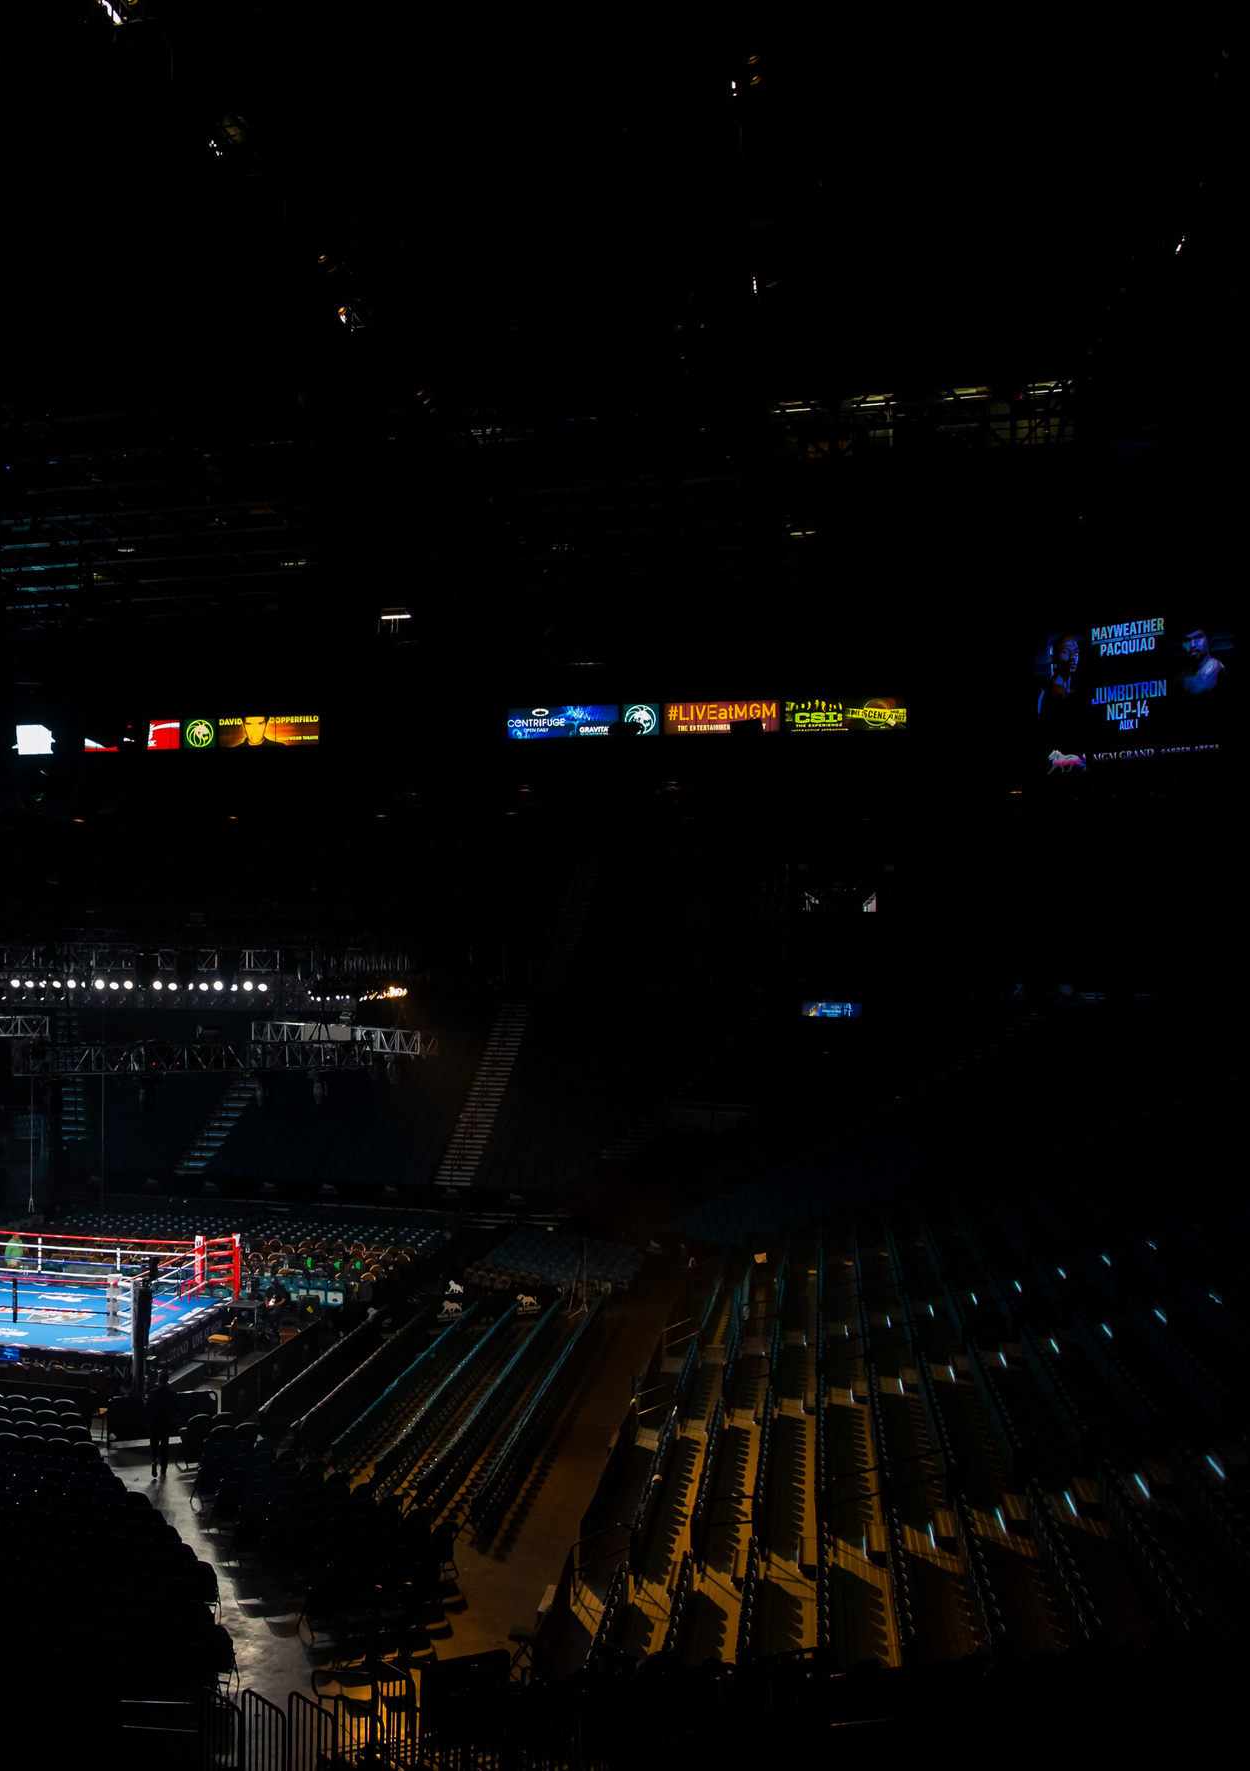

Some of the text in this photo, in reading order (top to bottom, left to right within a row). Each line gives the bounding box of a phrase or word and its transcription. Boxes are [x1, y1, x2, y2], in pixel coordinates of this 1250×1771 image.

[1091, 617, 1165, 641] MAYWEATHER
[1100, 636, 1156, 658] PACQUIAO
[1091, 679, 1167, 706] JUMBOTRON
[668, 702, 776, 721] #LIVEatMGM
[864, 710, 887, 719] SCENE
[1106, 699, 1150, 722] NCP-14
[219, 715, 319, 726] DAVID COPPERFIELD
[1119, 718, 1134, 731] AUX
[1092, 751, 1117, 764] MGM
[1119, 748, 1155, 760] GRAND
